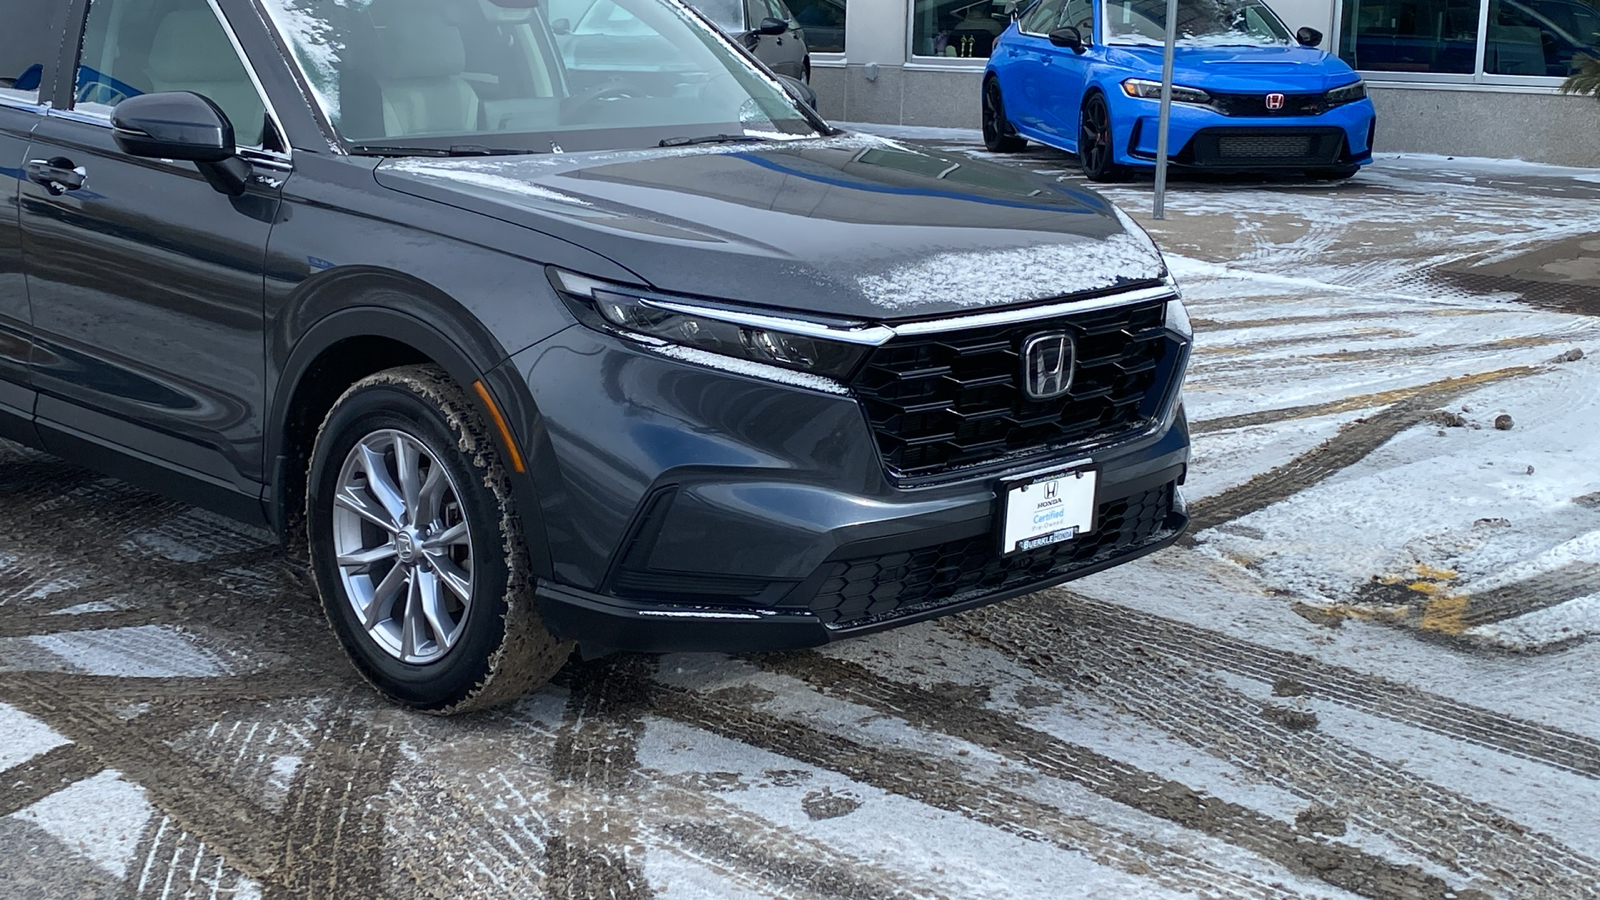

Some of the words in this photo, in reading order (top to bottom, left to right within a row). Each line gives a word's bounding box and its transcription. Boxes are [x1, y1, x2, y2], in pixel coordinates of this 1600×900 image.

[1037, 498, 1062, 509] HONDA
[1033, 507, 1065, 524] Certified
[1032, 519, 1064, 532] Pre-Owned
